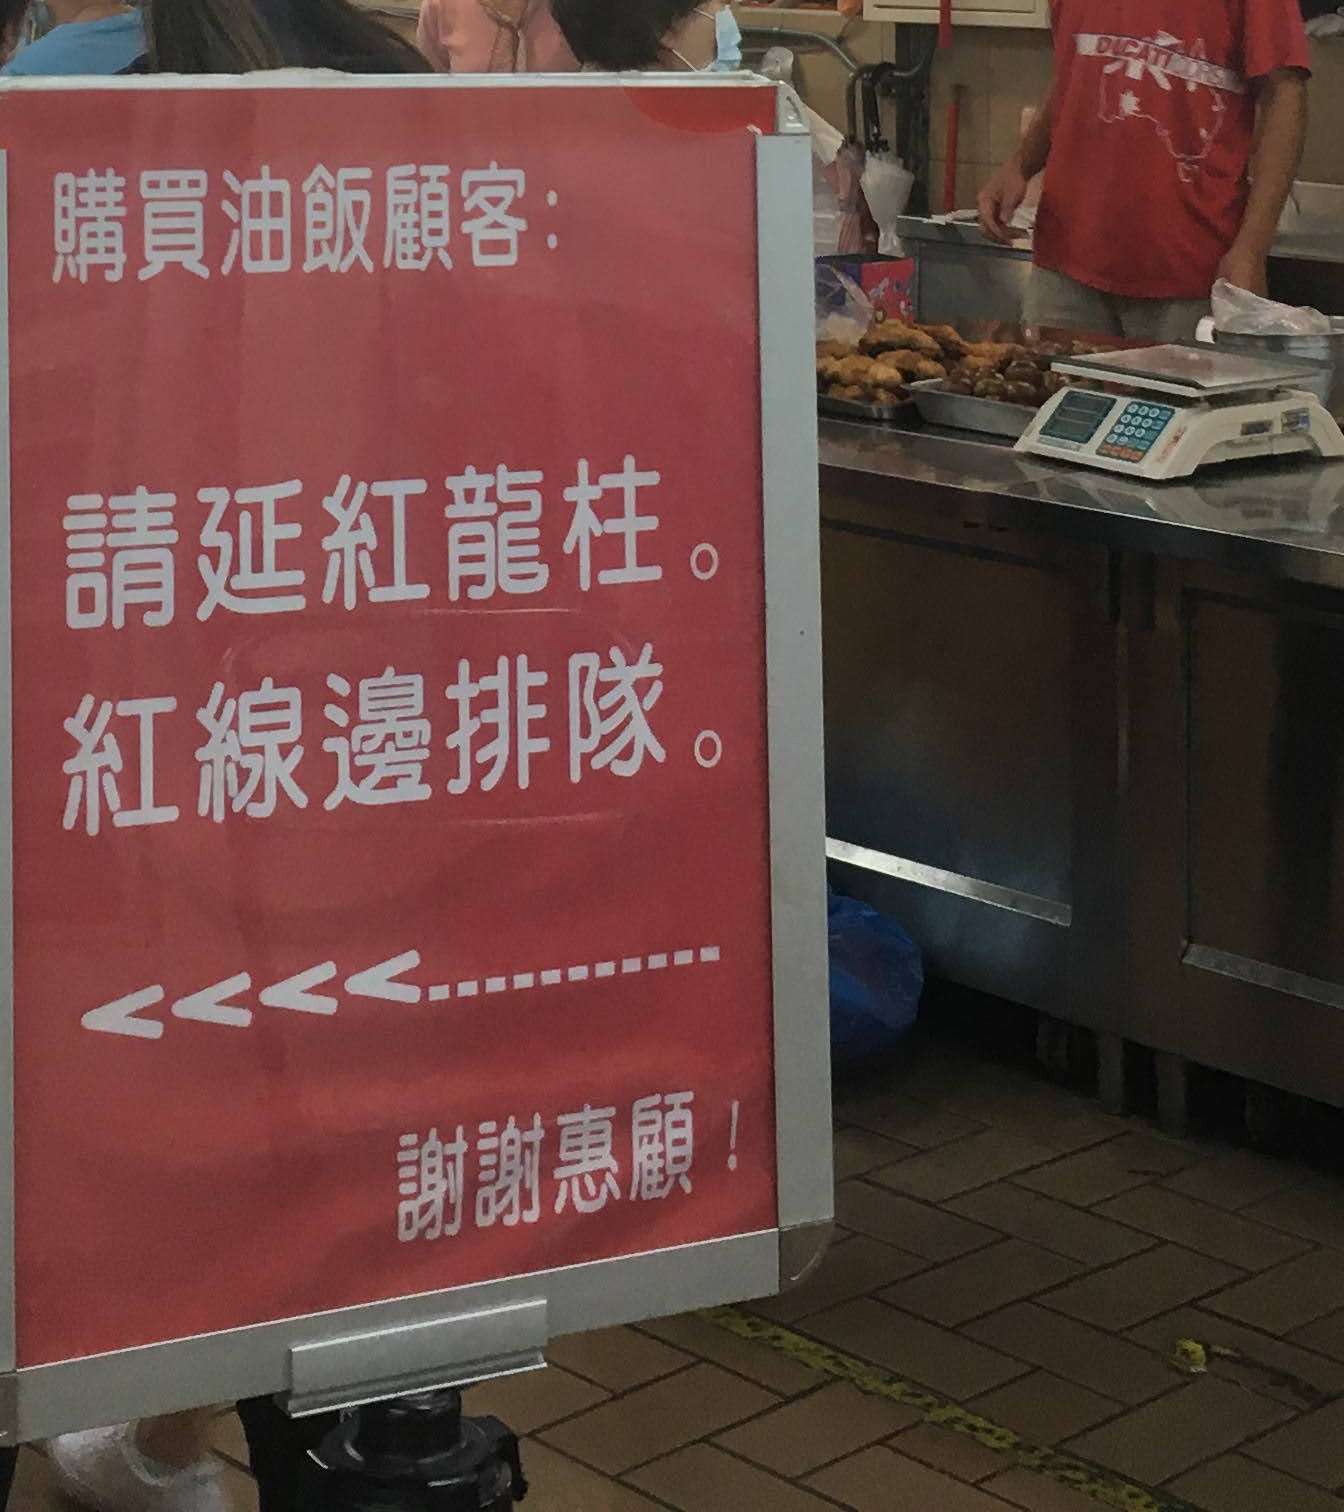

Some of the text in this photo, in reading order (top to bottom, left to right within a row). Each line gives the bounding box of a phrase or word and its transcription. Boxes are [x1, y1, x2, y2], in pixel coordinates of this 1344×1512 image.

[51, 161, 560, 285] 購買油飯顧客：
[62, 454, 721, 630] 請延紅龍柱。
[62, 642, 723, 838] 紅線邊排隊。
[396, 1089, 743, 1245] 謝謝惠顧！
